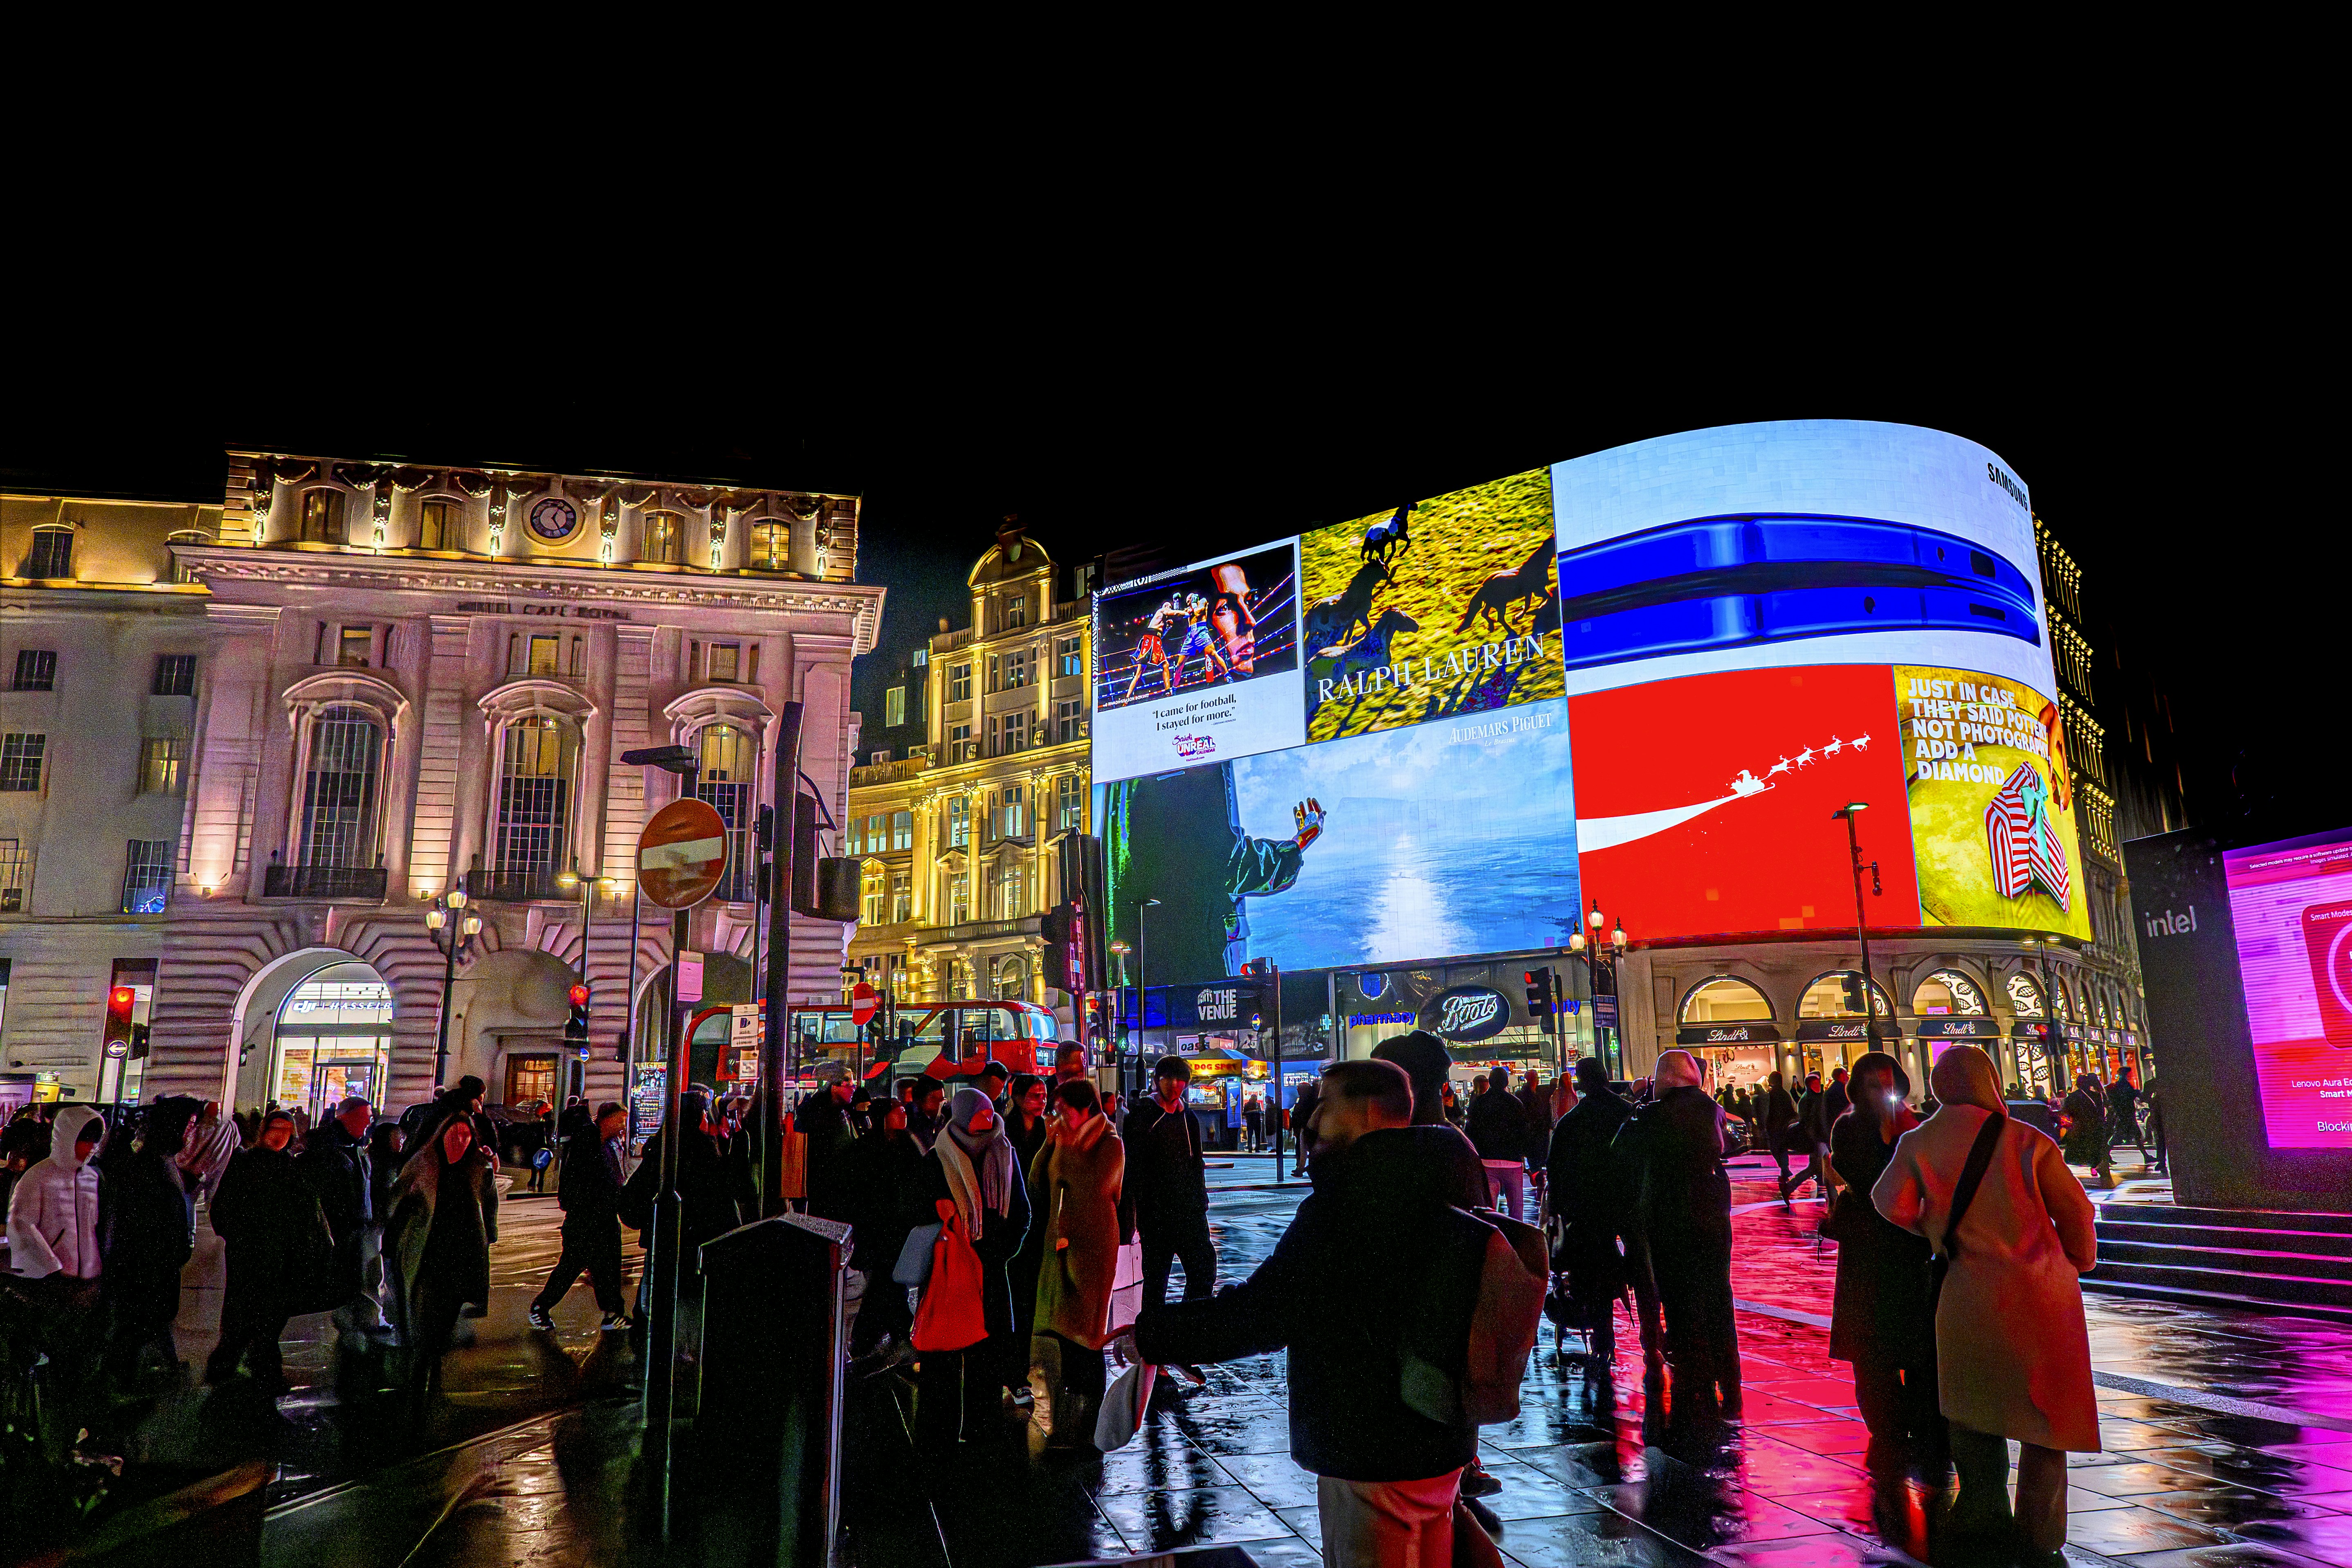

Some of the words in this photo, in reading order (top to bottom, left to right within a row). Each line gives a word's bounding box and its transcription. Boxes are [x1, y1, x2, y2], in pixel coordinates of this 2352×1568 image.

[1988, 463, 2028, 512] SAMSUNG
[1318, 661, 1412, 703] RALPH
[1424, 633, 1544, 681] LAUREN
[1908, 678, 1954, 699] JUST
[1959, 682, 1977, 702] IN
[1980, 685, 2017, 710] CASE
[1161, 706, 1183, 718] came
[1186, 703, 1198, 712] for
[1201, 693, 1236, 710] football,
[1909, 699, 1962, 720] THEY
[1967, 703, 2004, 725] SAID
[1157, 723, 1159, 731] I
[1162, 716, 1189, 730] stayed
[1192, 714, 1204, 724] for
[1449, 720, 1509, 744] AUDEMARS
[1512, 713, 1552, 732] PIGUET
[1912, 719, 1955, 740] NOT
[1173, 733, 1193, 745] Saudi
[1177, 738, 1216, 755] UNREAL
[1915, 739, 1958, 759] ADD
[1963, 742, 1977, 762] A
[1917, 761, 2005, 785] DIAMOND
[2145, 905, 2198, 938] intel
[2310, 912, 2330, 921] Smart
[1213, 989, 1236, 1004] THE
[1198, 1004, 1237, 1020] VENUE
[1350, 1011, 1415, 1029] pharmacy
[1437, 994, 1498, 1033] Boots
[1707, 1029, 1740, 1041] Lindt
[1828, 1025, 1860, 1037] Lindt
[1942, 1022, 1968, 1035] Lindt
[2319, 1090, 2345, 1098] Smart
